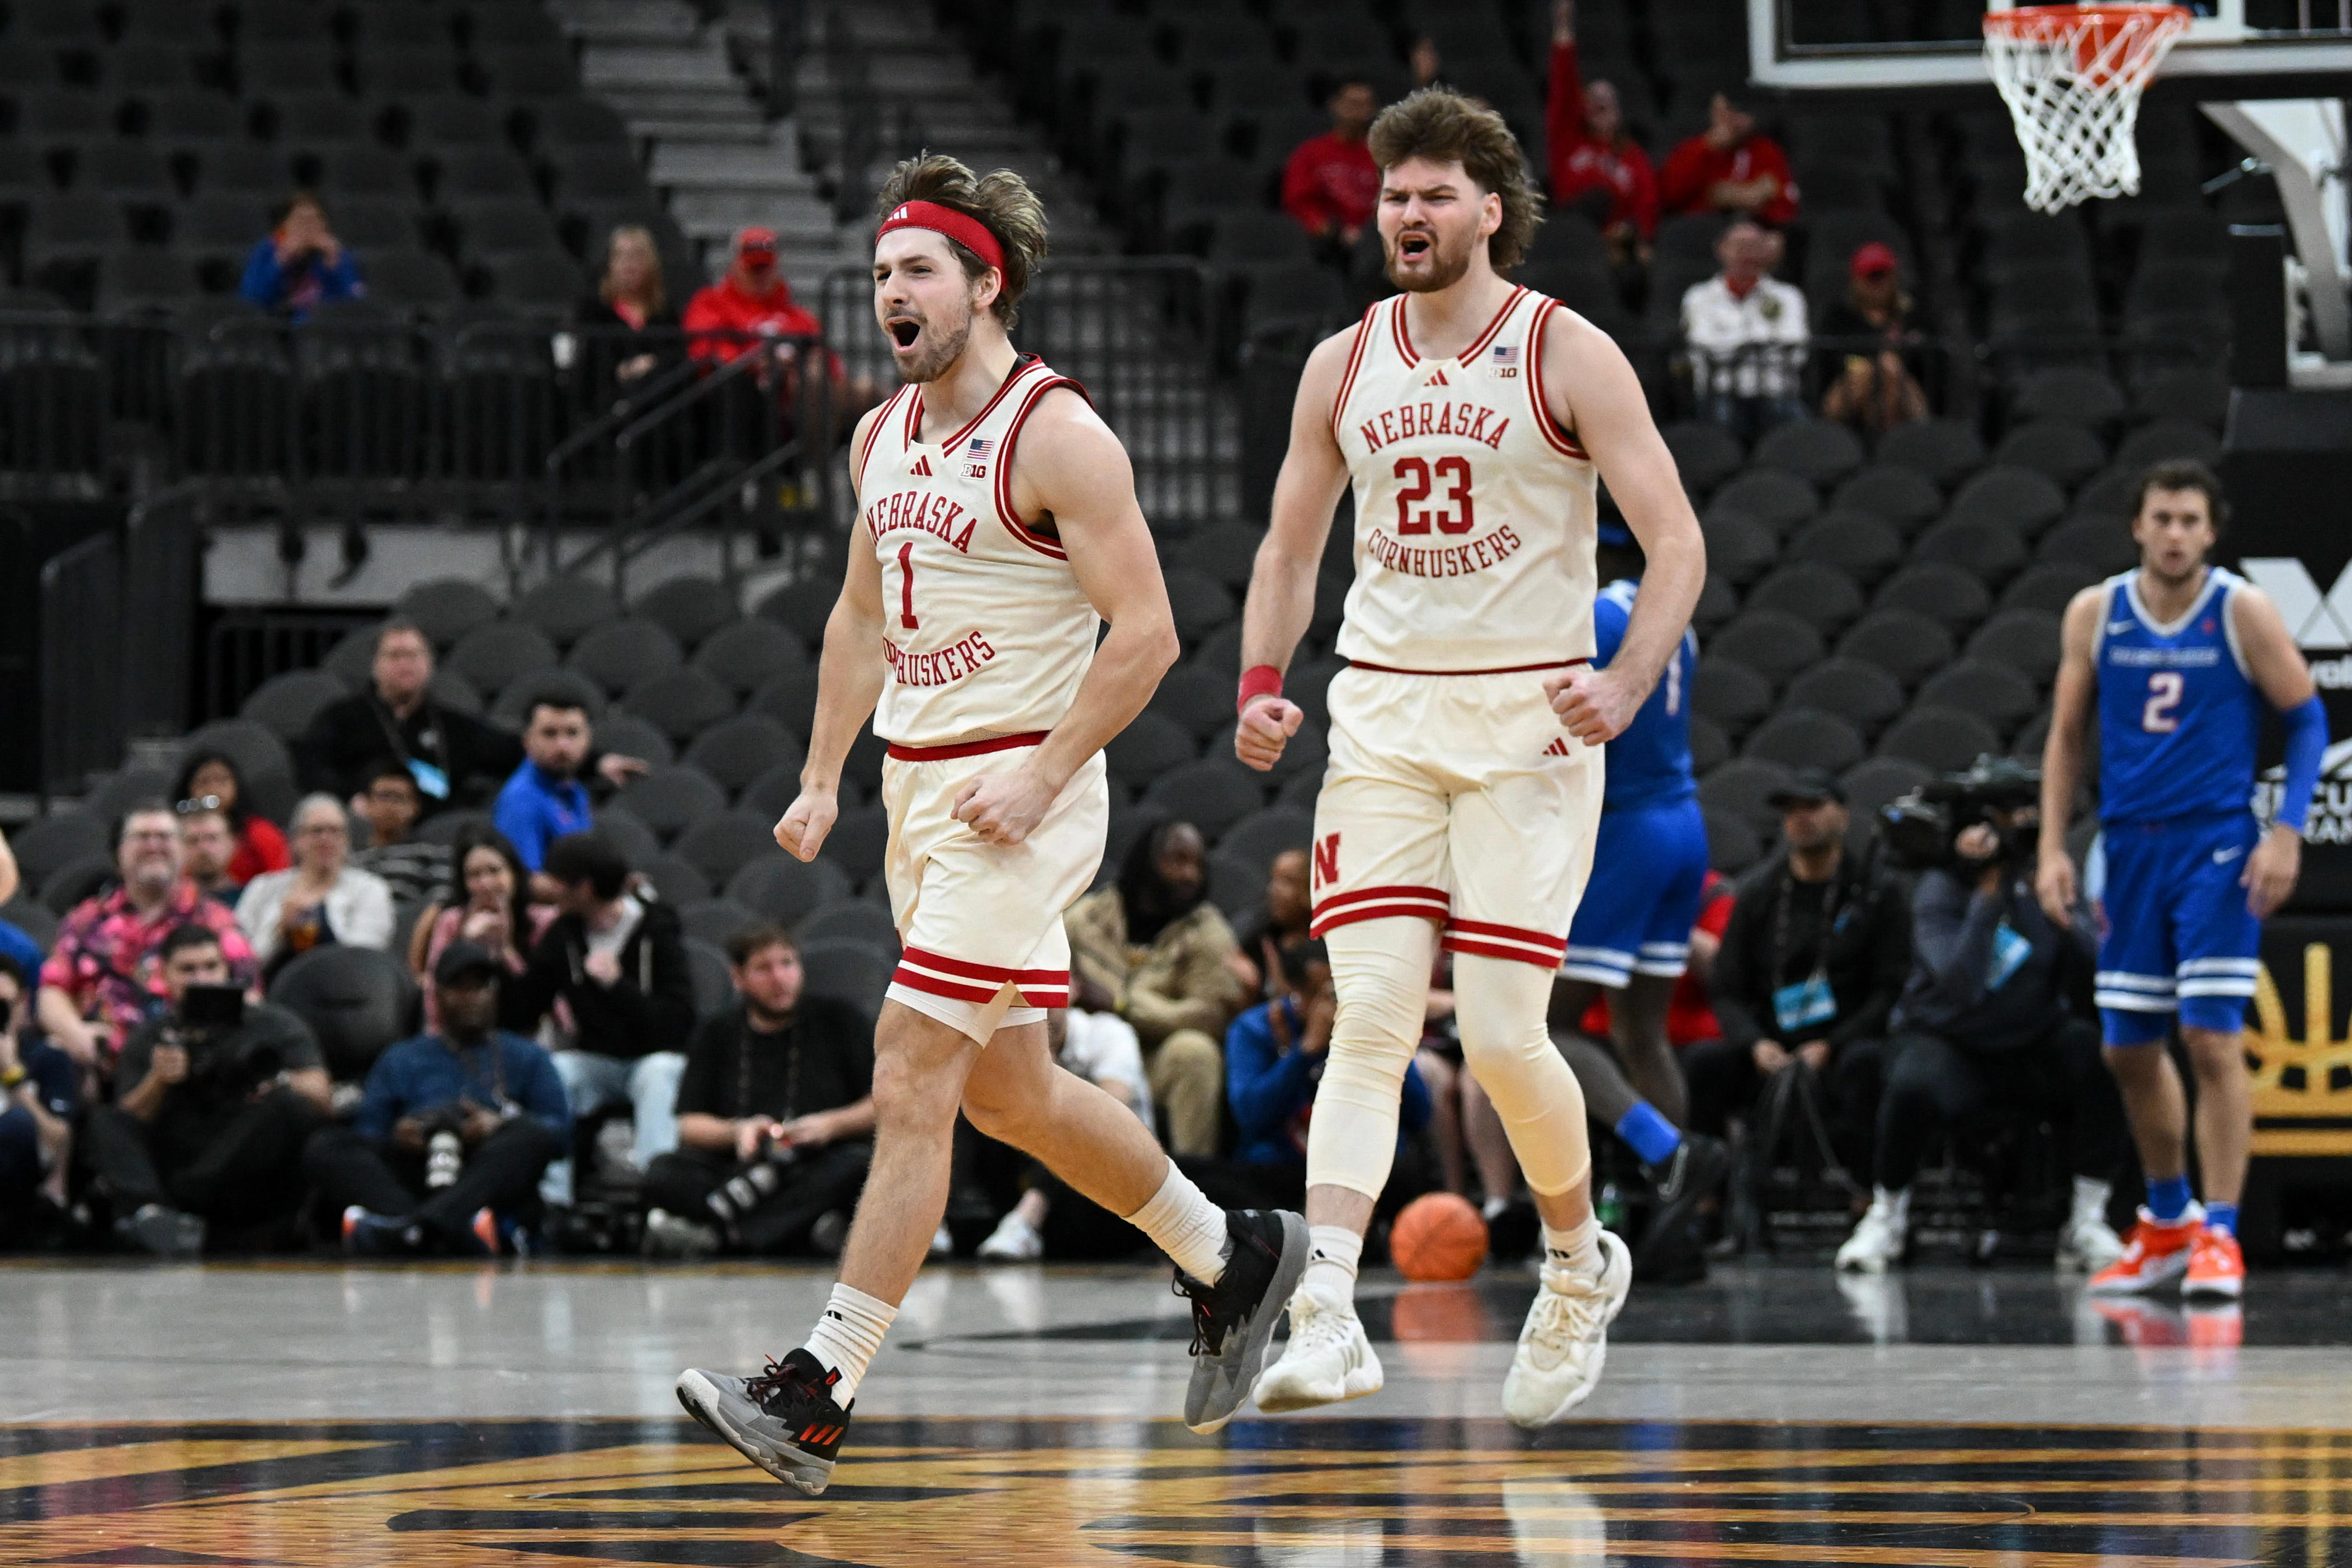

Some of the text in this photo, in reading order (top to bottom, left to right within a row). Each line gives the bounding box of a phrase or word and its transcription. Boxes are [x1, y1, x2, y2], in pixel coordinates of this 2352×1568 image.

[1360, 402, 1510, 455] NEBRASKA
[867, 491, 977, 554] NEBRASKA
[1394, 456, 1474, 535] 23
[1368, 525, 1521, 578] CORNHUSKERS
[897, 542, 919, 630] 1
[883, 631, 995, 687] ORHUSKERS
[2142, 672, 2184, 733] 2
[1314, 833, 1341, 891] N
